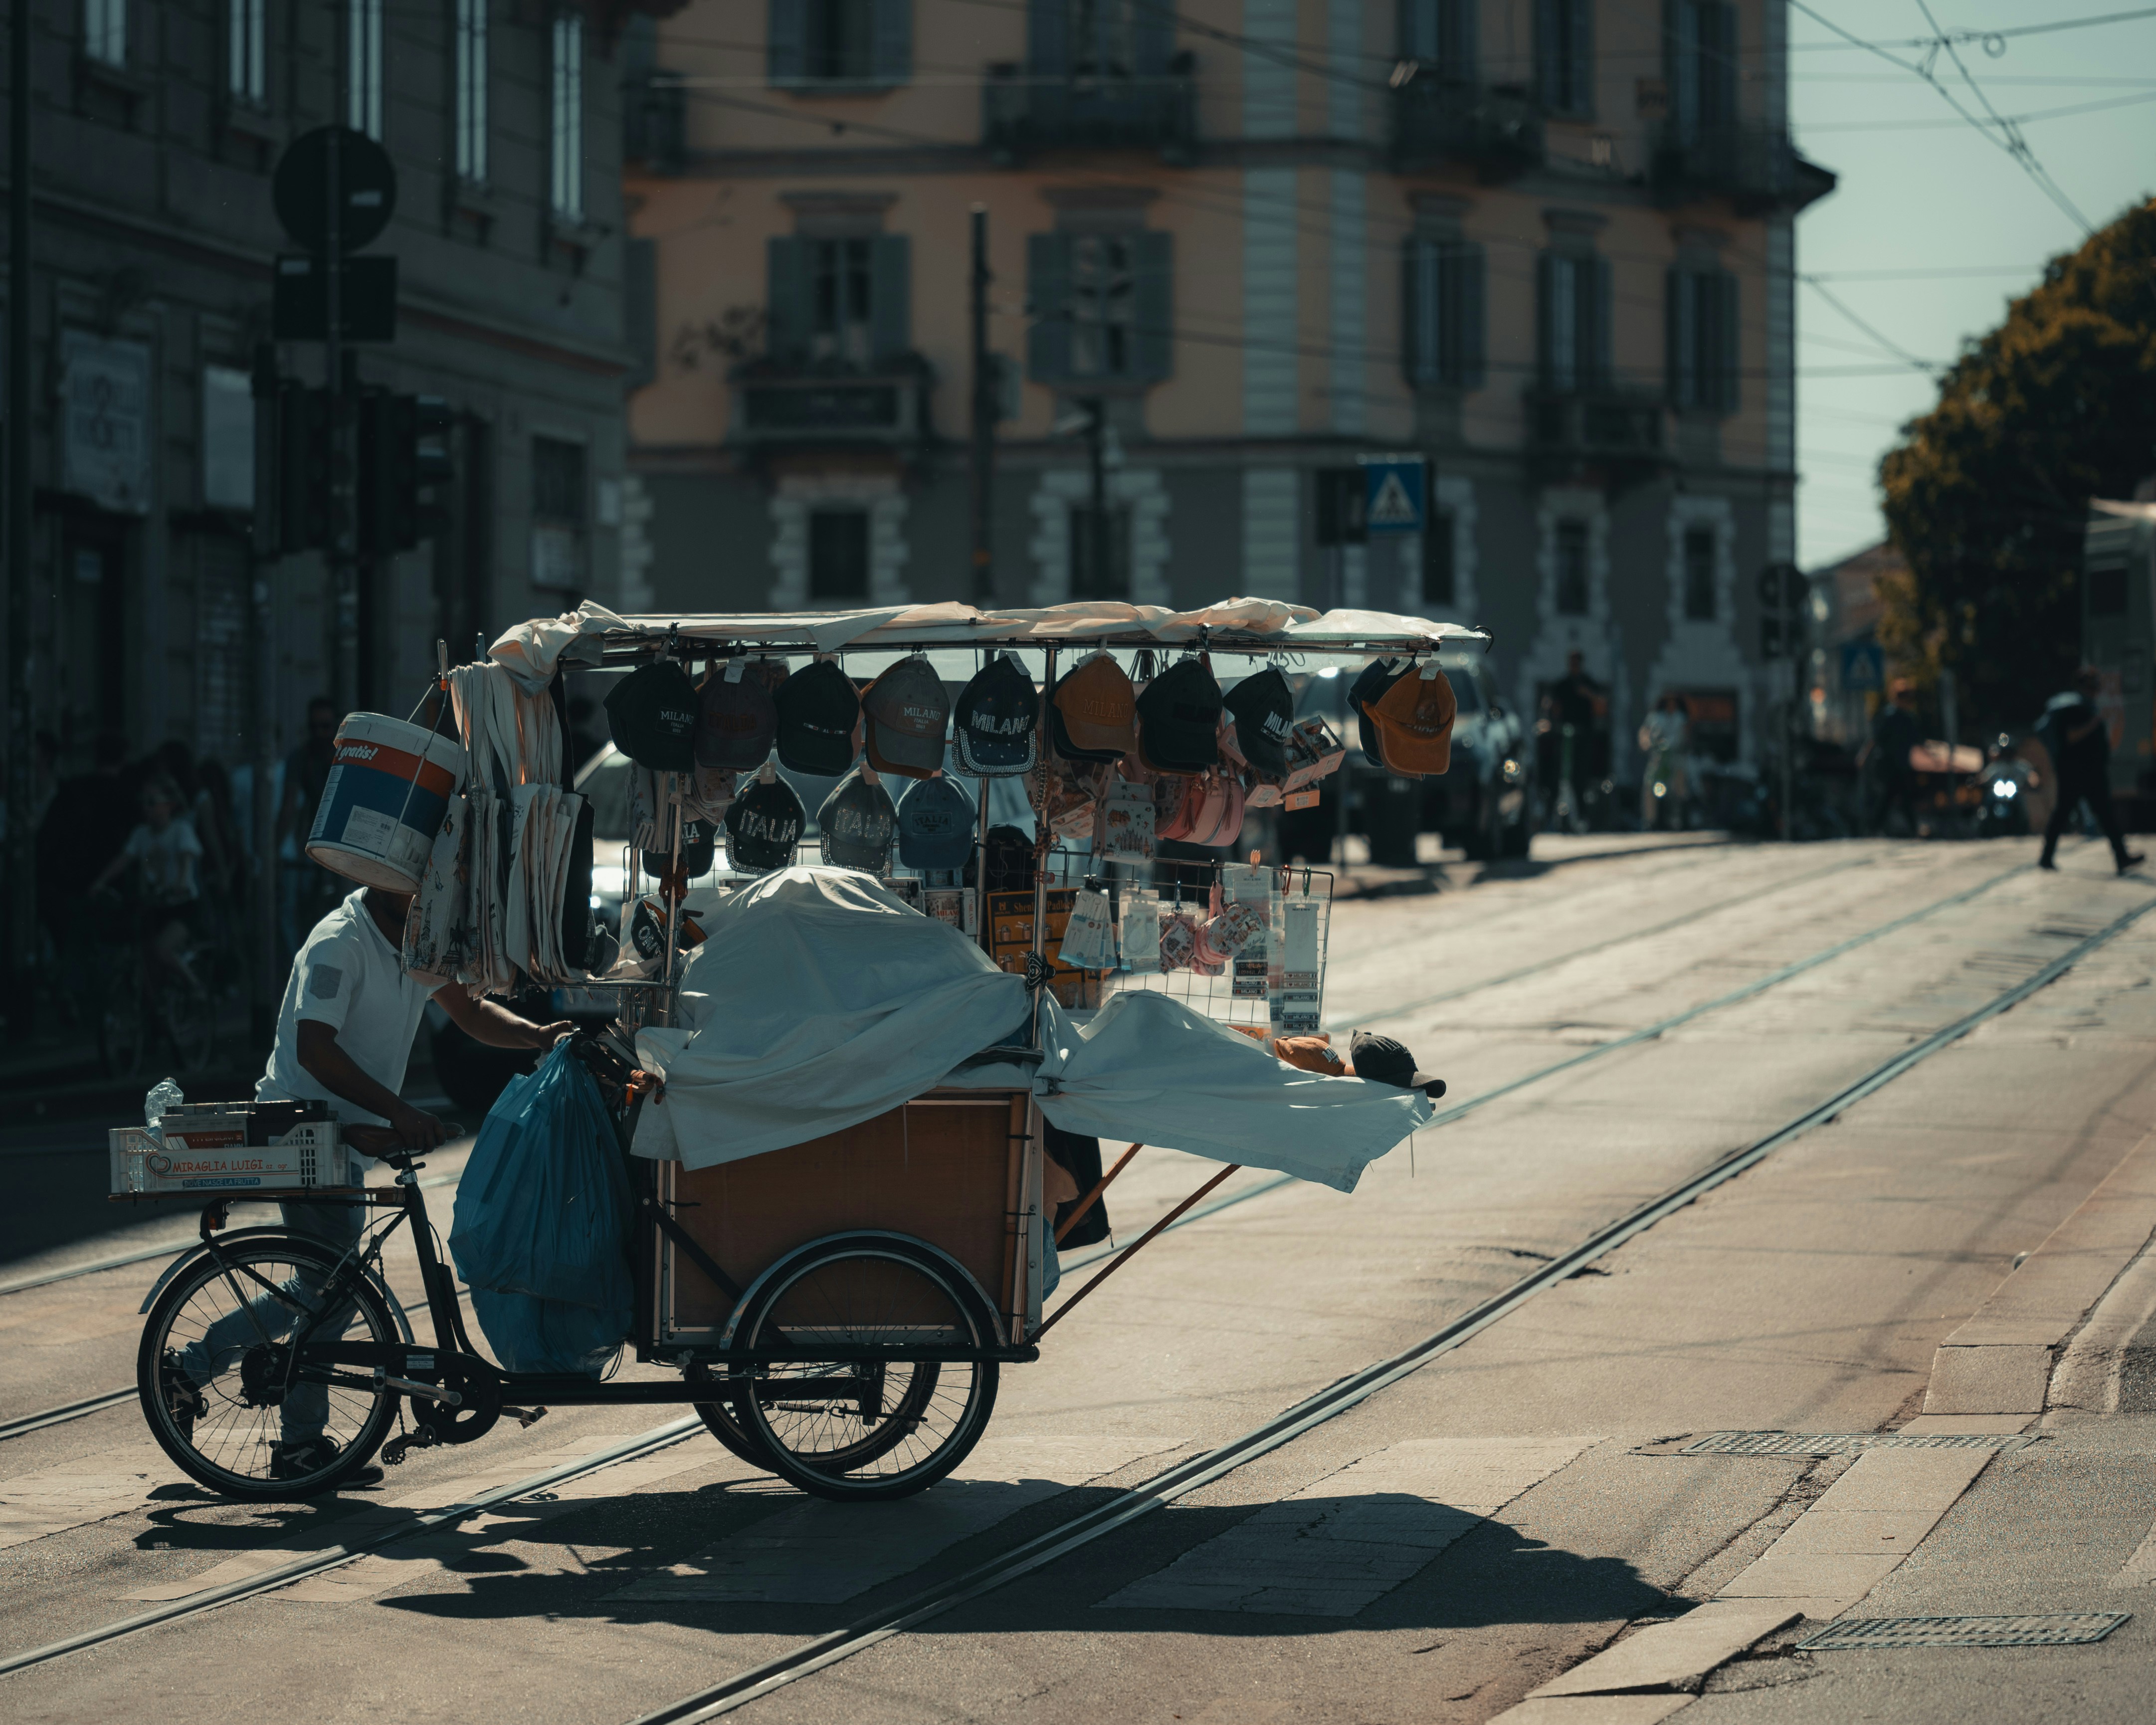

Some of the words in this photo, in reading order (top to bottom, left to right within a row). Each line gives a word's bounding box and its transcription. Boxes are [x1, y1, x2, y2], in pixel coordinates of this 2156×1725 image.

[903, 707, 941, 721] MILANO
[1083, 699, 1129, 718] MILANO
[660, 711, 694, 725] MILANO
[972, 710, 1030, 736] MILANO
[338, 745, 379, 761] gratis!
[739, 808, 797, 842] ITALIA
[834, 807, 891, 838] ITALIA
[914, 815, 949, 826] ITALIA
[1014, 902, 1034, 913] Shenl
[173, 1161, 227, 1173] MIRAGLIA
[231, 1159, 263, 1170] LUIGI
